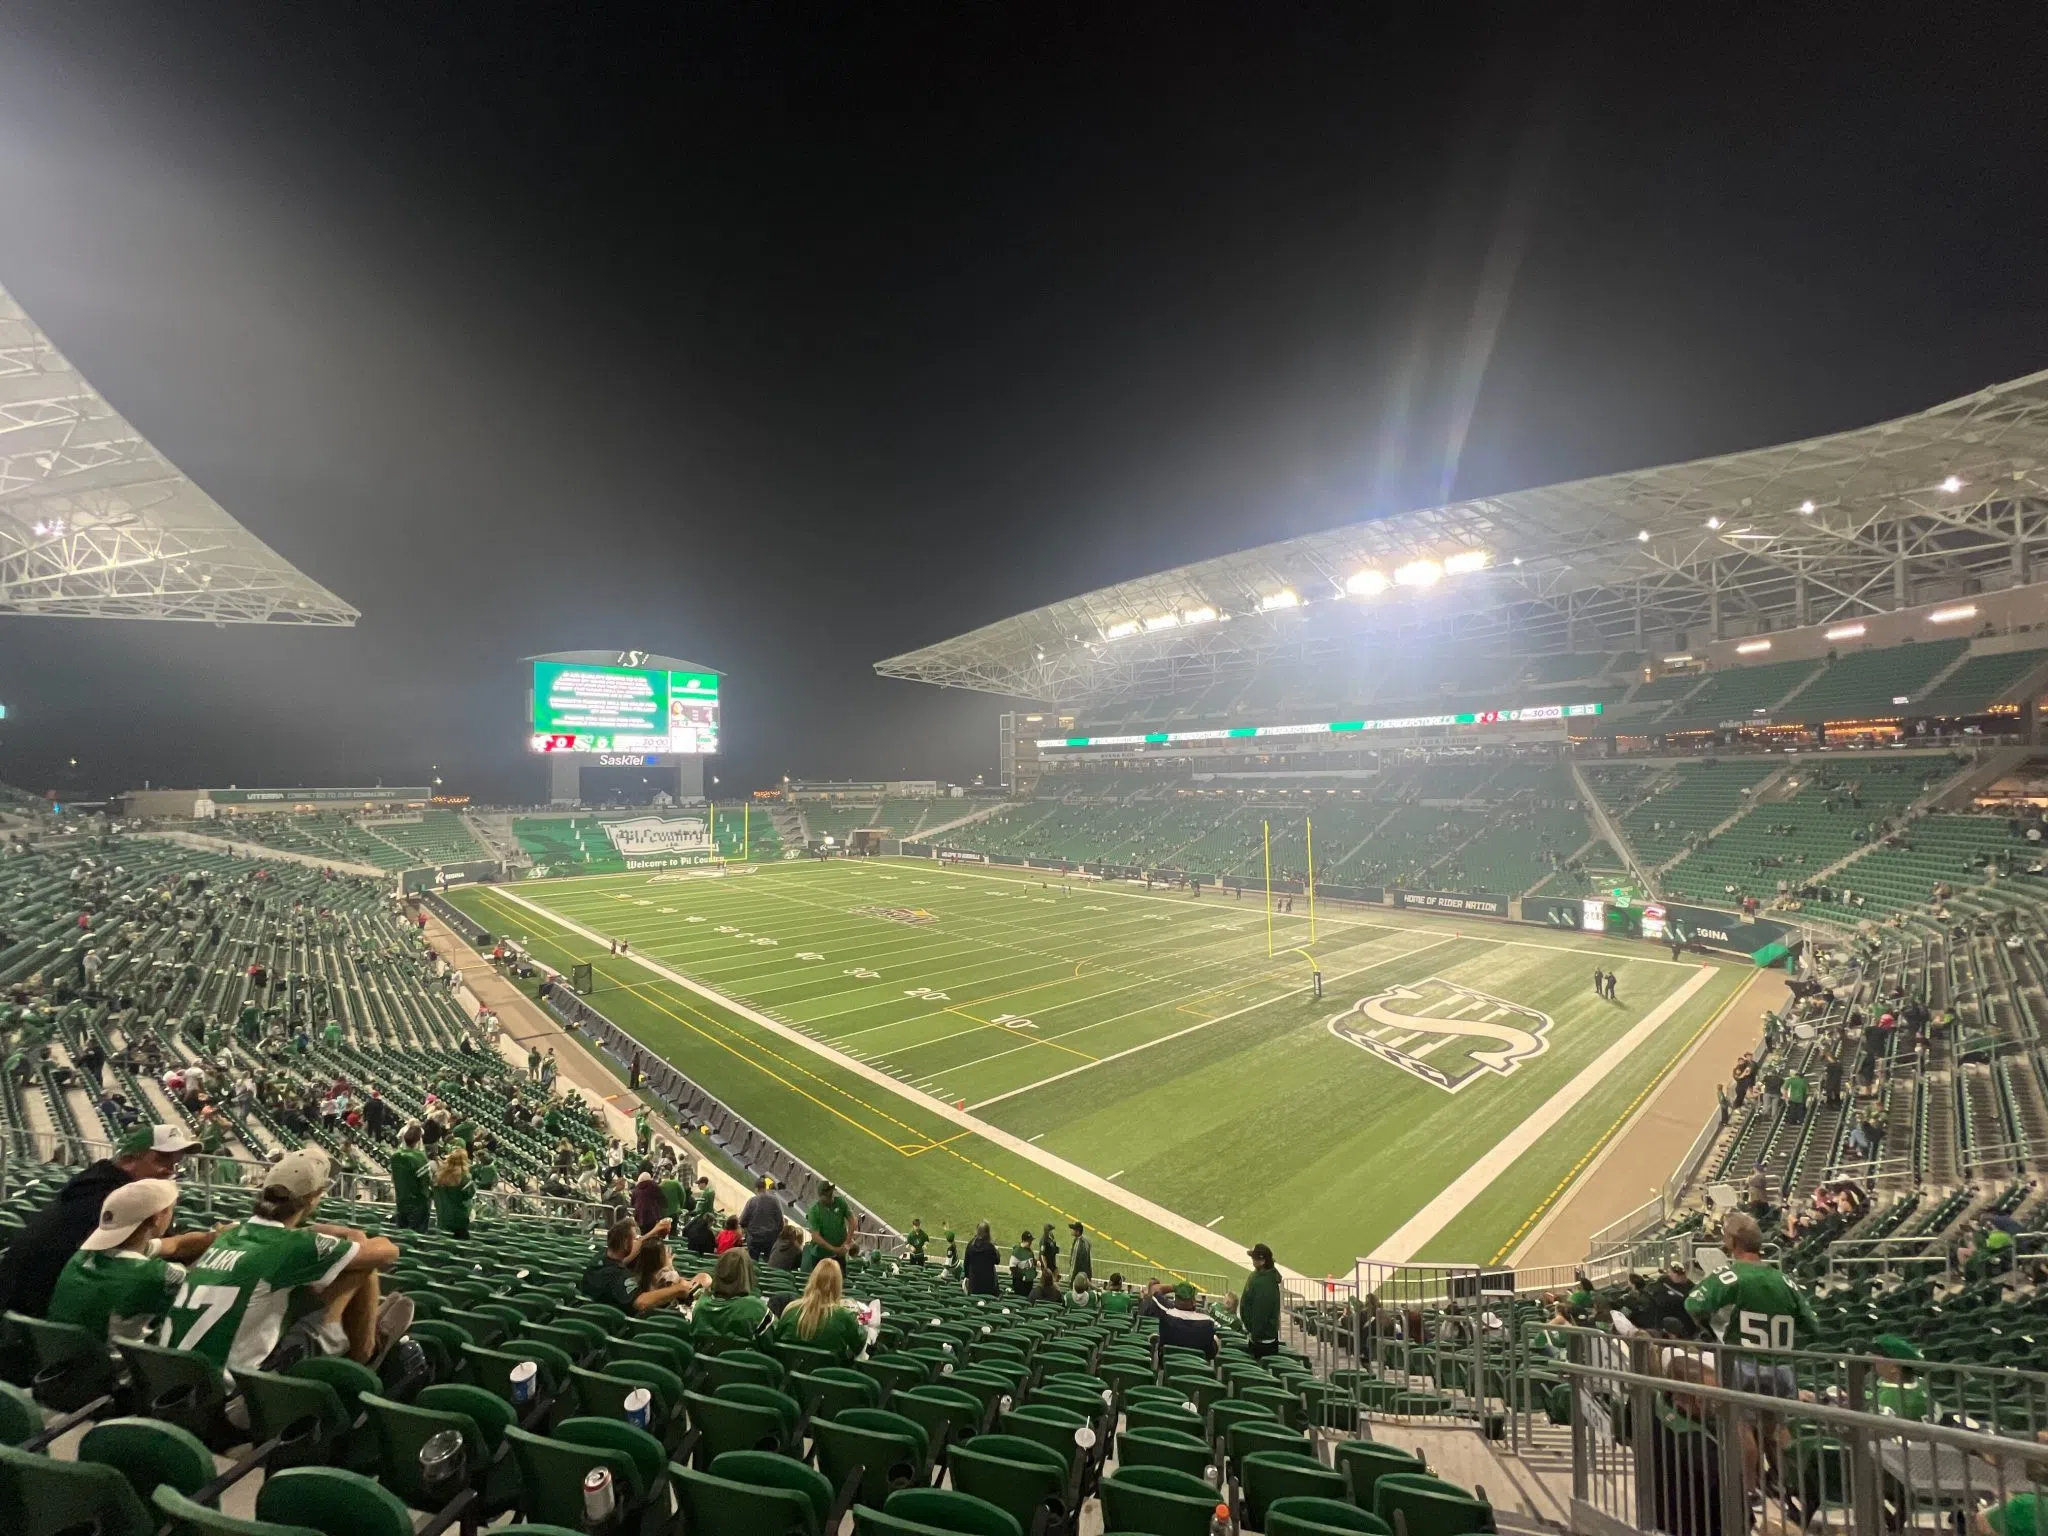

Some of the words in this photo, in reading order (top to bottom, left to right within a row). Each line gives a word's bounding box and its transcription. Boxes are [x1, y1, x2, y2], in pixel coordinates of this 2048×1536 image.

[599, 754, 644, 766] SaskTel
[626, 860, 668, 870] Welcome
[669, 857, 678, 866] to
[680, 856, 691, 865] Pil
[1404, 894, 1425, 904] HOME
[1426, 897, 1437, 905] OF
[1438, 898, 1463, 909] RIDER
[1465, 900, 1498, 912] NATION
[1697, 927, 1728, 942] EGINA
[843, 967, 873, 978] 30
[903, 987, 946, 1000] 20
[991, 1013, 1032, 1029] 10
[196, 1247, 247, 1272] CLARK
[1739, 1310, 1795, 1350] 50
